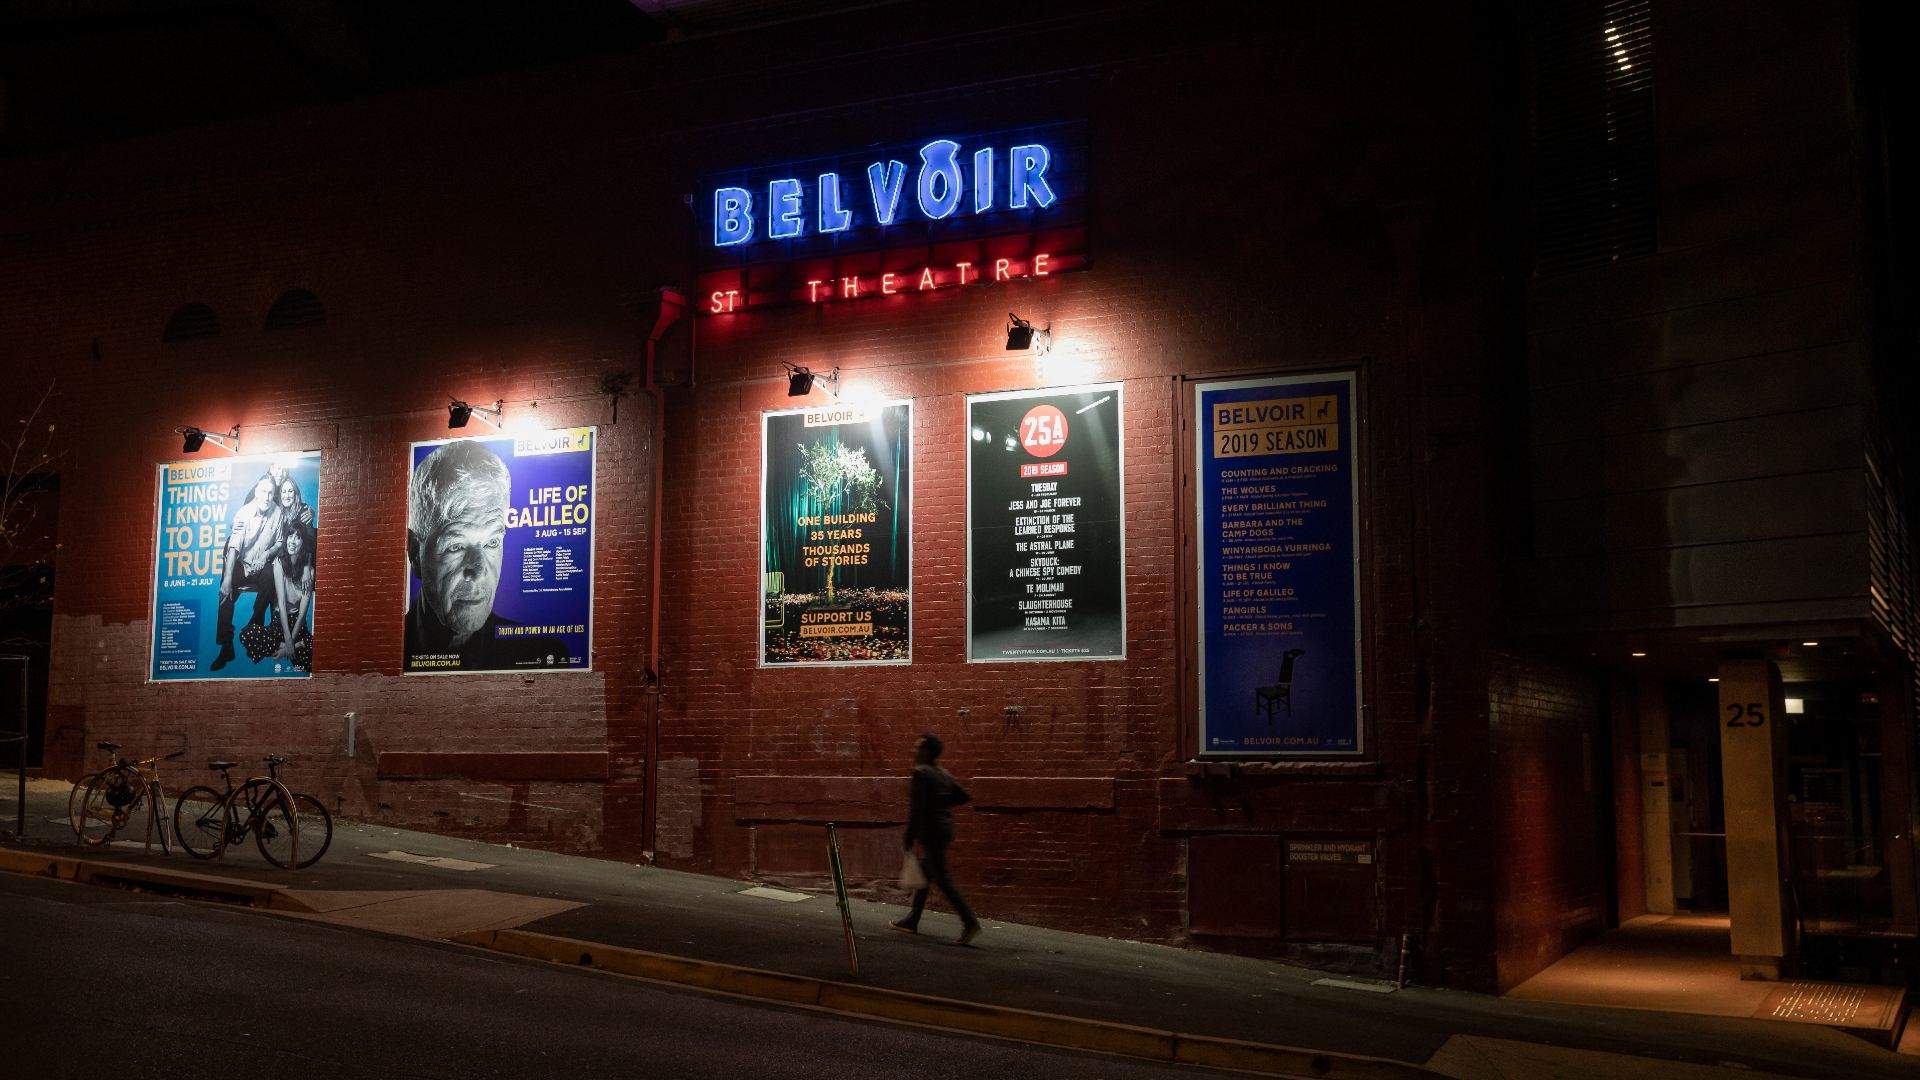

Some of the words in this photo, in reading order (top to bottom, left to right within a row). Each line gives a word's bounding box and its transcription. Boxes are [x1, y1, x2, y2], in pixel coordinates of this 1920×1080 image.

[714, 140, 1057, 247] BELVOIR
[710, 290, 738, 314] ST
[808, 254, 1050, 302] THEATRE
[808, 411, 853, 424] BELVOIR
[1218, 404, 1304, 426] BELVOIR
[1024, 415, 1066, 446] 25A
[517, 436, 570, 452] BELVOIR
[1221, 432, 1259, 454] 2019
[1265, 428, 1327, 452] SEASON
[171, 466, 215, 481] BELVOIR
[1040, 464, 1065, 475] SEASON
[1221, 468, 1268, 478] COUNTING
[1270, 467, 1289, 475] AND
[1291, 464, 1338, 474] CRACKING
[168, 482, 230, 504] THINGS
[1031, 482, 1057, 492] TUESDAY
[1240, 485, 1276, 494] WOLVES
[530, 486, 561, 505] LIFE
[565, 485, 588, 503] OF
[1008, 501, 1024, 510] JESS
[1026, 500, 1038, 509] AND
[1040, 499, 1052, 508] JOE
[1054, 497, 1081, 508] FOREVER
[1222, 504, 1249, 513] EVERY
[1251, 502, 1296, 511] BRILLIANT
[1300, 500, 1327, 508] THING
[167, 507, 172, 524] I
[176, 504, 227, 524] KNOW
[505, 503, 589, 529] GALILEO
[797, 516, 820, 526] ONE
[824, 513, 876, 525] BUILDING
[1016, 516, 1050, 526] EXTINCTION
[1052, 515, 1060, 524] OF
[1062, 514, 1074, 523] THE
[1015, 526, 1042, 535] LEARNED
[1044, 524, 1075, 534] RESPONSE
[1222, 520, 1263, 529] BARBARA
[1265, 519, 1284, 527] AND
[166, 526, 193, 550] TO
[199, 524, 227, 548] BE
[542, 529, 557, 538] AUG
[810, 531, 824, 541] 35
[826, 529, 862, 540] YEARS
[1222, 530, 1247, 538] CAMP
[1249, 528, 1274, 537] DOGS
[802, 544, 870, 556] THOUSANDS
[1016, 542, 1028, 552] THE
[1029, 541, 1052, 551] ASTRAL
[1054, 540, 1074, 549] PLANE
[1222, 545, 1282, 555] WINYANBOGA
[1284, 544, 1332, 552] YURRINGA
[164, 550, 224, 576] TRUE
[805, 557, 818, 567] OF
[822, 555, 868, 566] STORIES
[1030, 557, 1060, 567] SKYDUCK:
[1222, 564, 1256, 572] THINGS
[1264, 562, 1291, 570] KNOW
[1009, 569, 1014, 578] A
[1015, 567, 1040, 577] CHINESE
[1042, 567, 1054, 576] SPY
[1056, 566, 1081, 576] COMEDY
[1026, 584, 1034, 593] TE
[1257, 588, 1294, 597] GALILEO
[1018, 599, 1073, 610] SLAUGHTERHOUSE
[1223, 606, 1267, 614] FANGIRLS
[801, 612, 853, 624] SUPPORT
[855, 611, 872, 621] US
[1026, 617, 1050, 626] KASAMA
[1052, 616, 1066, 626] KITA
[499, 627, 513, 636] TRUTH
[525, 627, 540, 635] POWER
[803, 626, 870, 635] BELVOIR.COM.AU
[1224, 623, 1258, 632] PACKER
[1726, 704, 1765, 728] 25
[1244, 737, 1319, 745] BELVOIR.COM.AU
